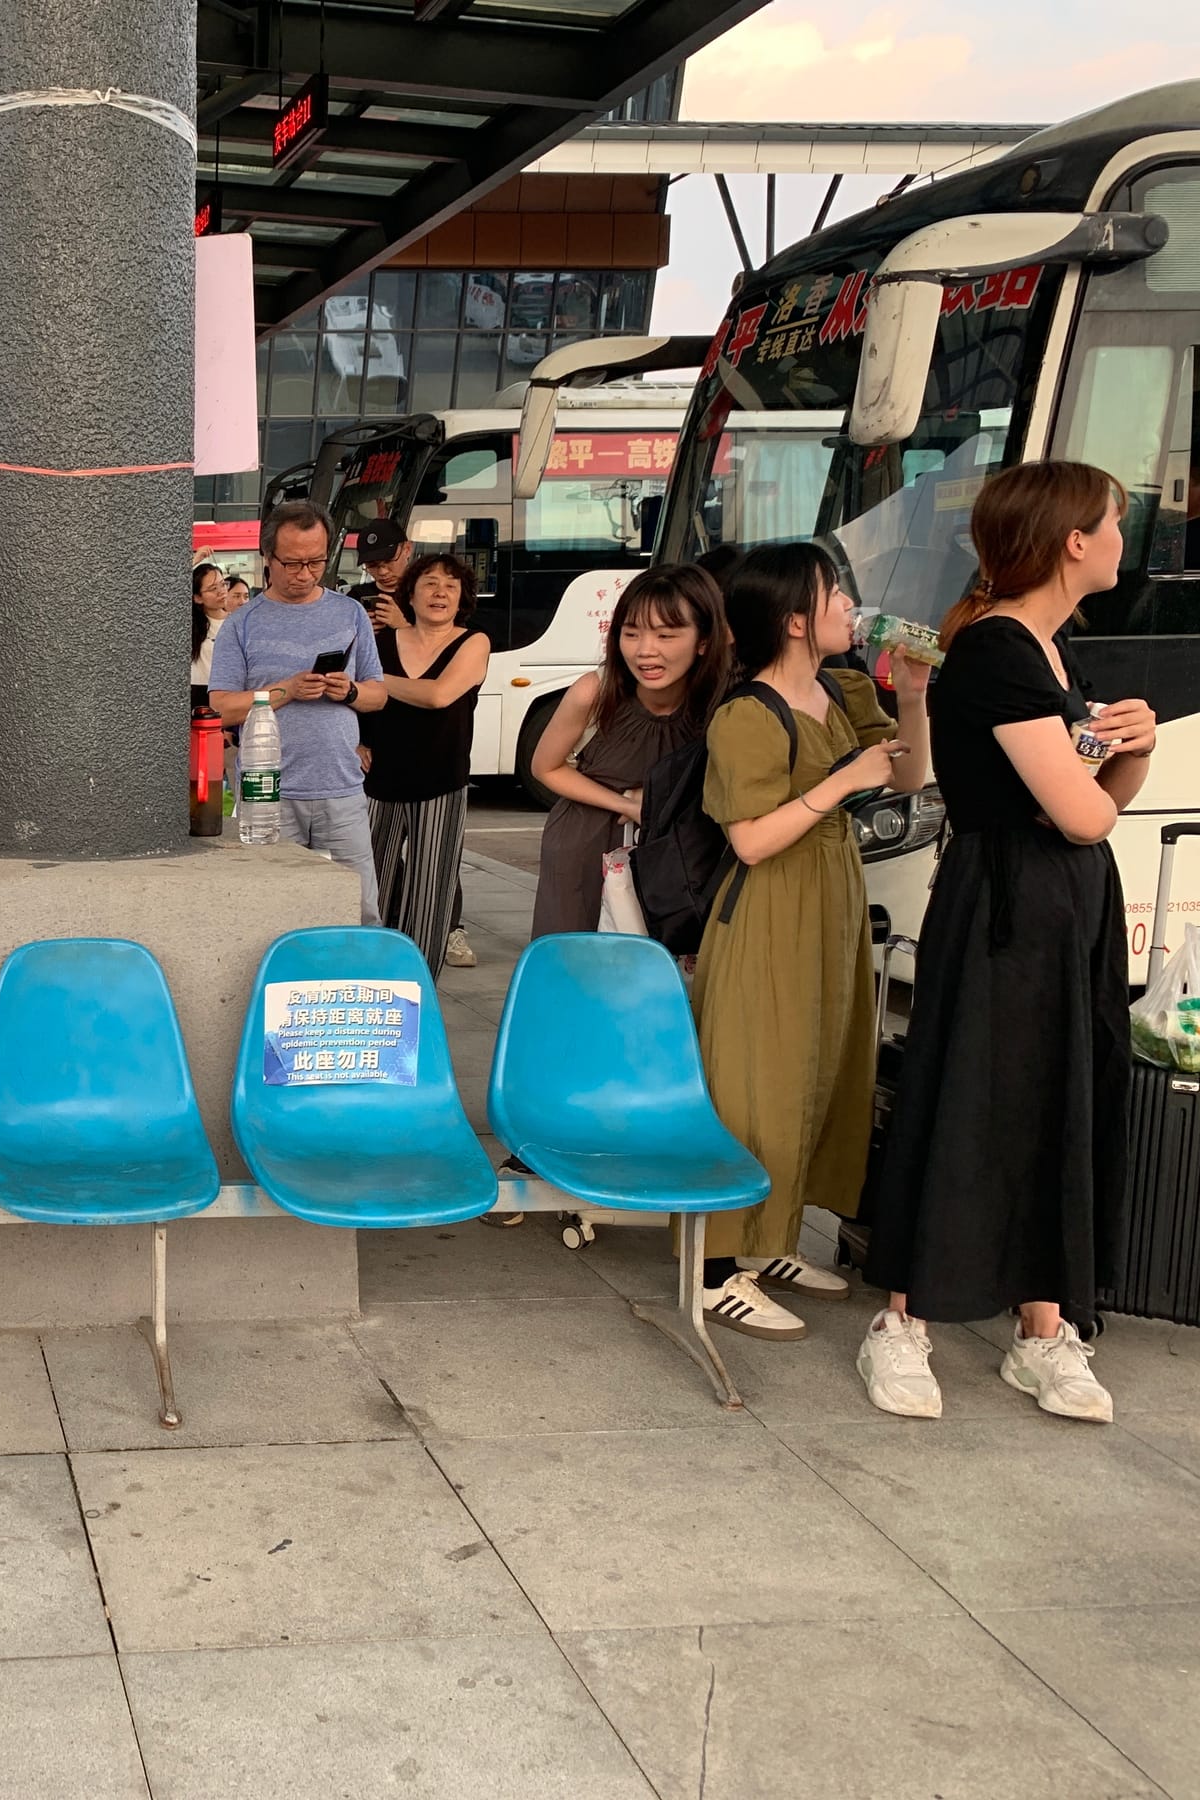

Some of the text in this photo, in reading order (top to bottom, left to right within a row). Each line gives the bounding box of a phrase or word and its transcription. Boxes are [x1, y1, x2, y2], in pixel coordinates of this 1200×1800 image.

[771, 273, 834, 325] 洛香
[757, 324, 817, 364] 专线直达
[278, 1029, 303, 1038] Please
[305, 1029, 325, 1038] keep
[335, 1028, 370, 1036] distance
[374, 1028, 402, 1038] during
[281, 1039, 397, 1050] epidemic prevention period
[293, 1050, 380, 1071] 此座勿用
[286, 1073, 303, 1081] This
[352, 1072, 389, 1080] available
